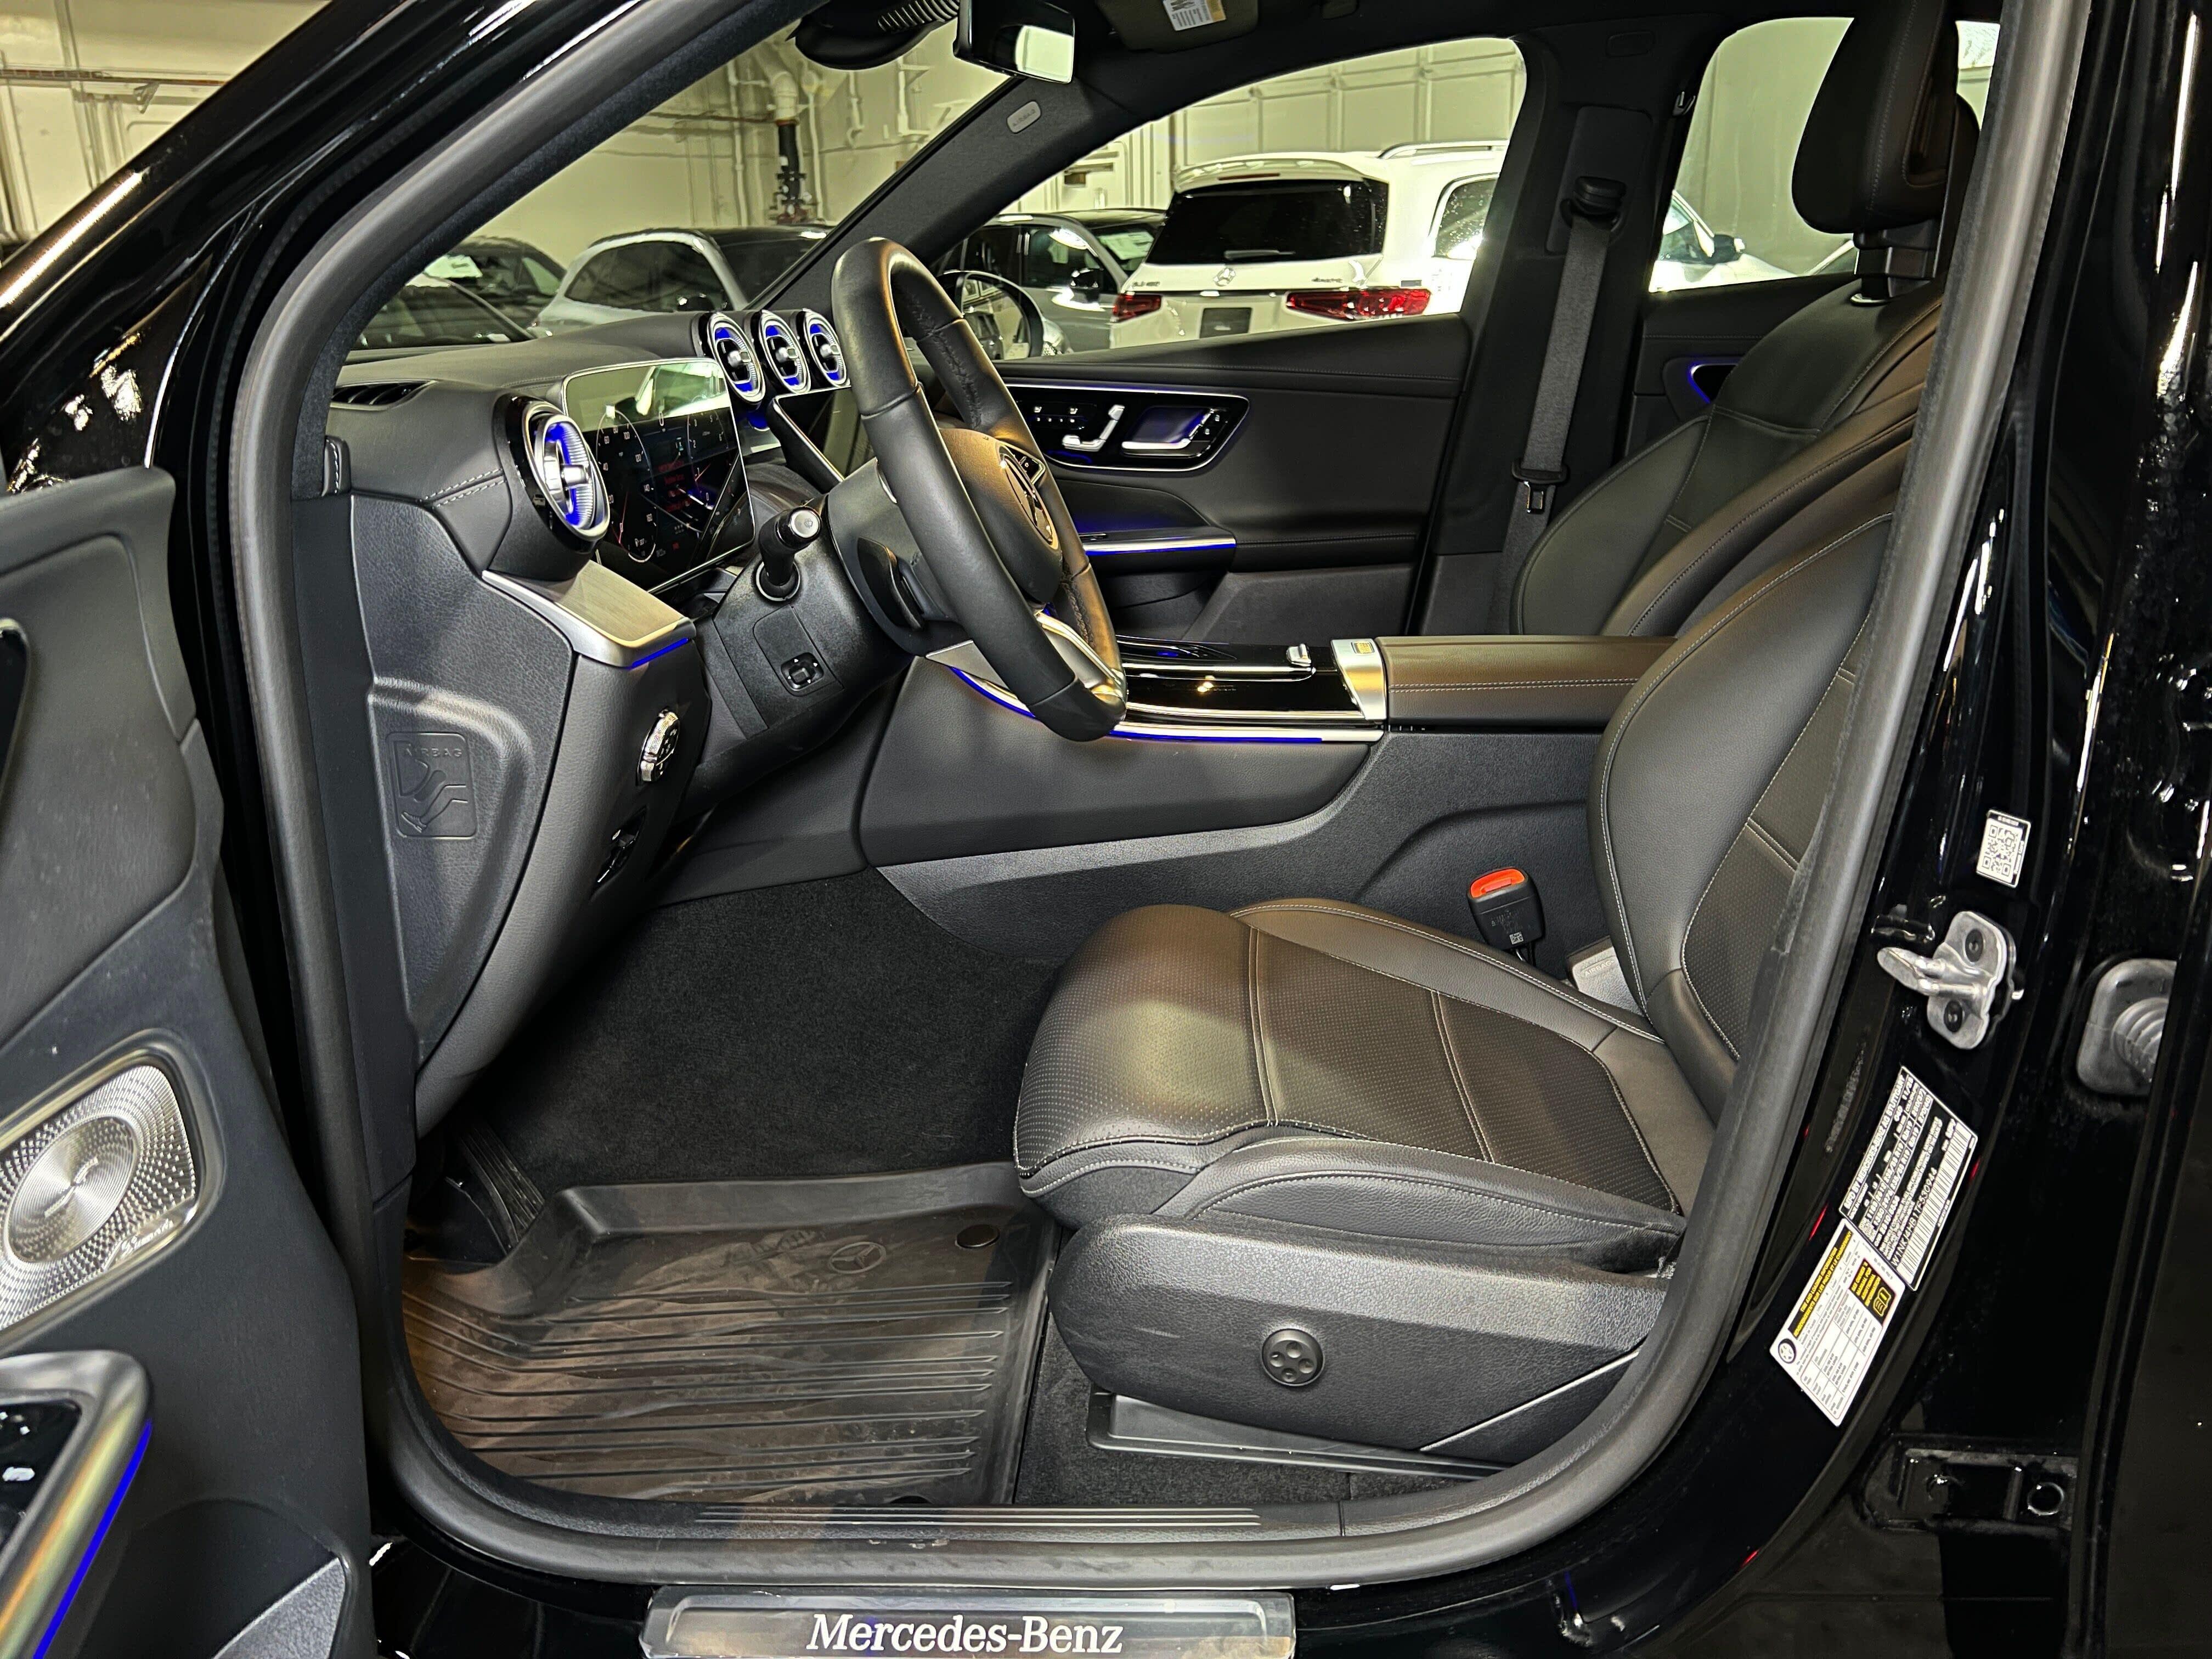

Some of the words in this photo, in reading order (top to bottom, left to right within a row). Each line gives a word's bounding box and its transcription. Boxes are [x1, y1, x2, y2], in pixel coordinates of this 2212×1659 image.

[1584, 960, 1612, 977] AIRBAG
[1884, 1074, 1907, 1118] STUTTGART
[1881, 1113, 1891, 1128] AG
[1857, 1124, 1886, 1185] MERCEDES-BENZ
[1851, 1179, 1861, 1194] BY
[1843, 1189, 1856, 1211] MFD
[1804, 1291, 1813, 1304] AND
[1810, 1274, 1823, 1295] LOADING
[806, 1613, 1124, 1654] Mercedes-Benz
